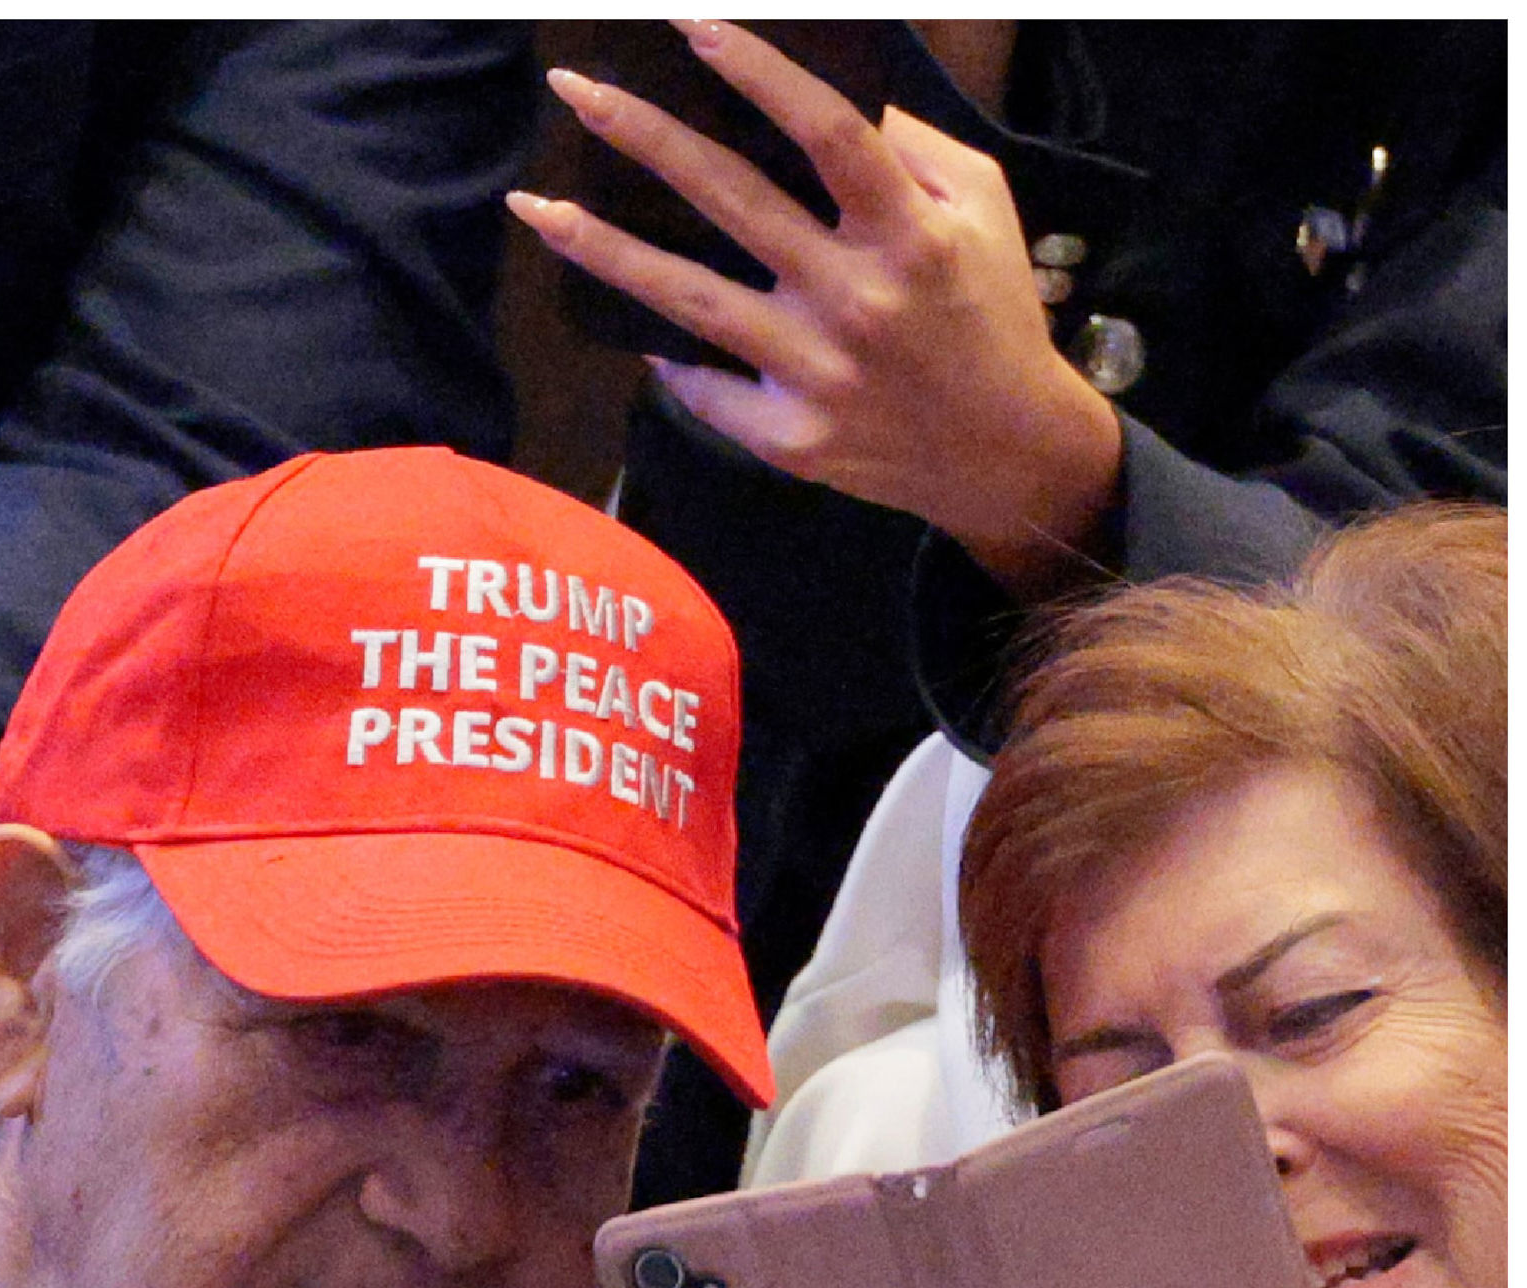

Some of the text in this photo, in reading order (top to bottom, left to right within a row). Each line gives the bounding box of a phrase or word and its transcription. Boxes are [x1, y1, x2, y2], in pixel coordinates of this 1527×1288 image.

[417, 556, 652, 651] TRUMP
[351, 629, 700, 752] THE PEACE
[346, 707, 695, 830] PRESIDENT
